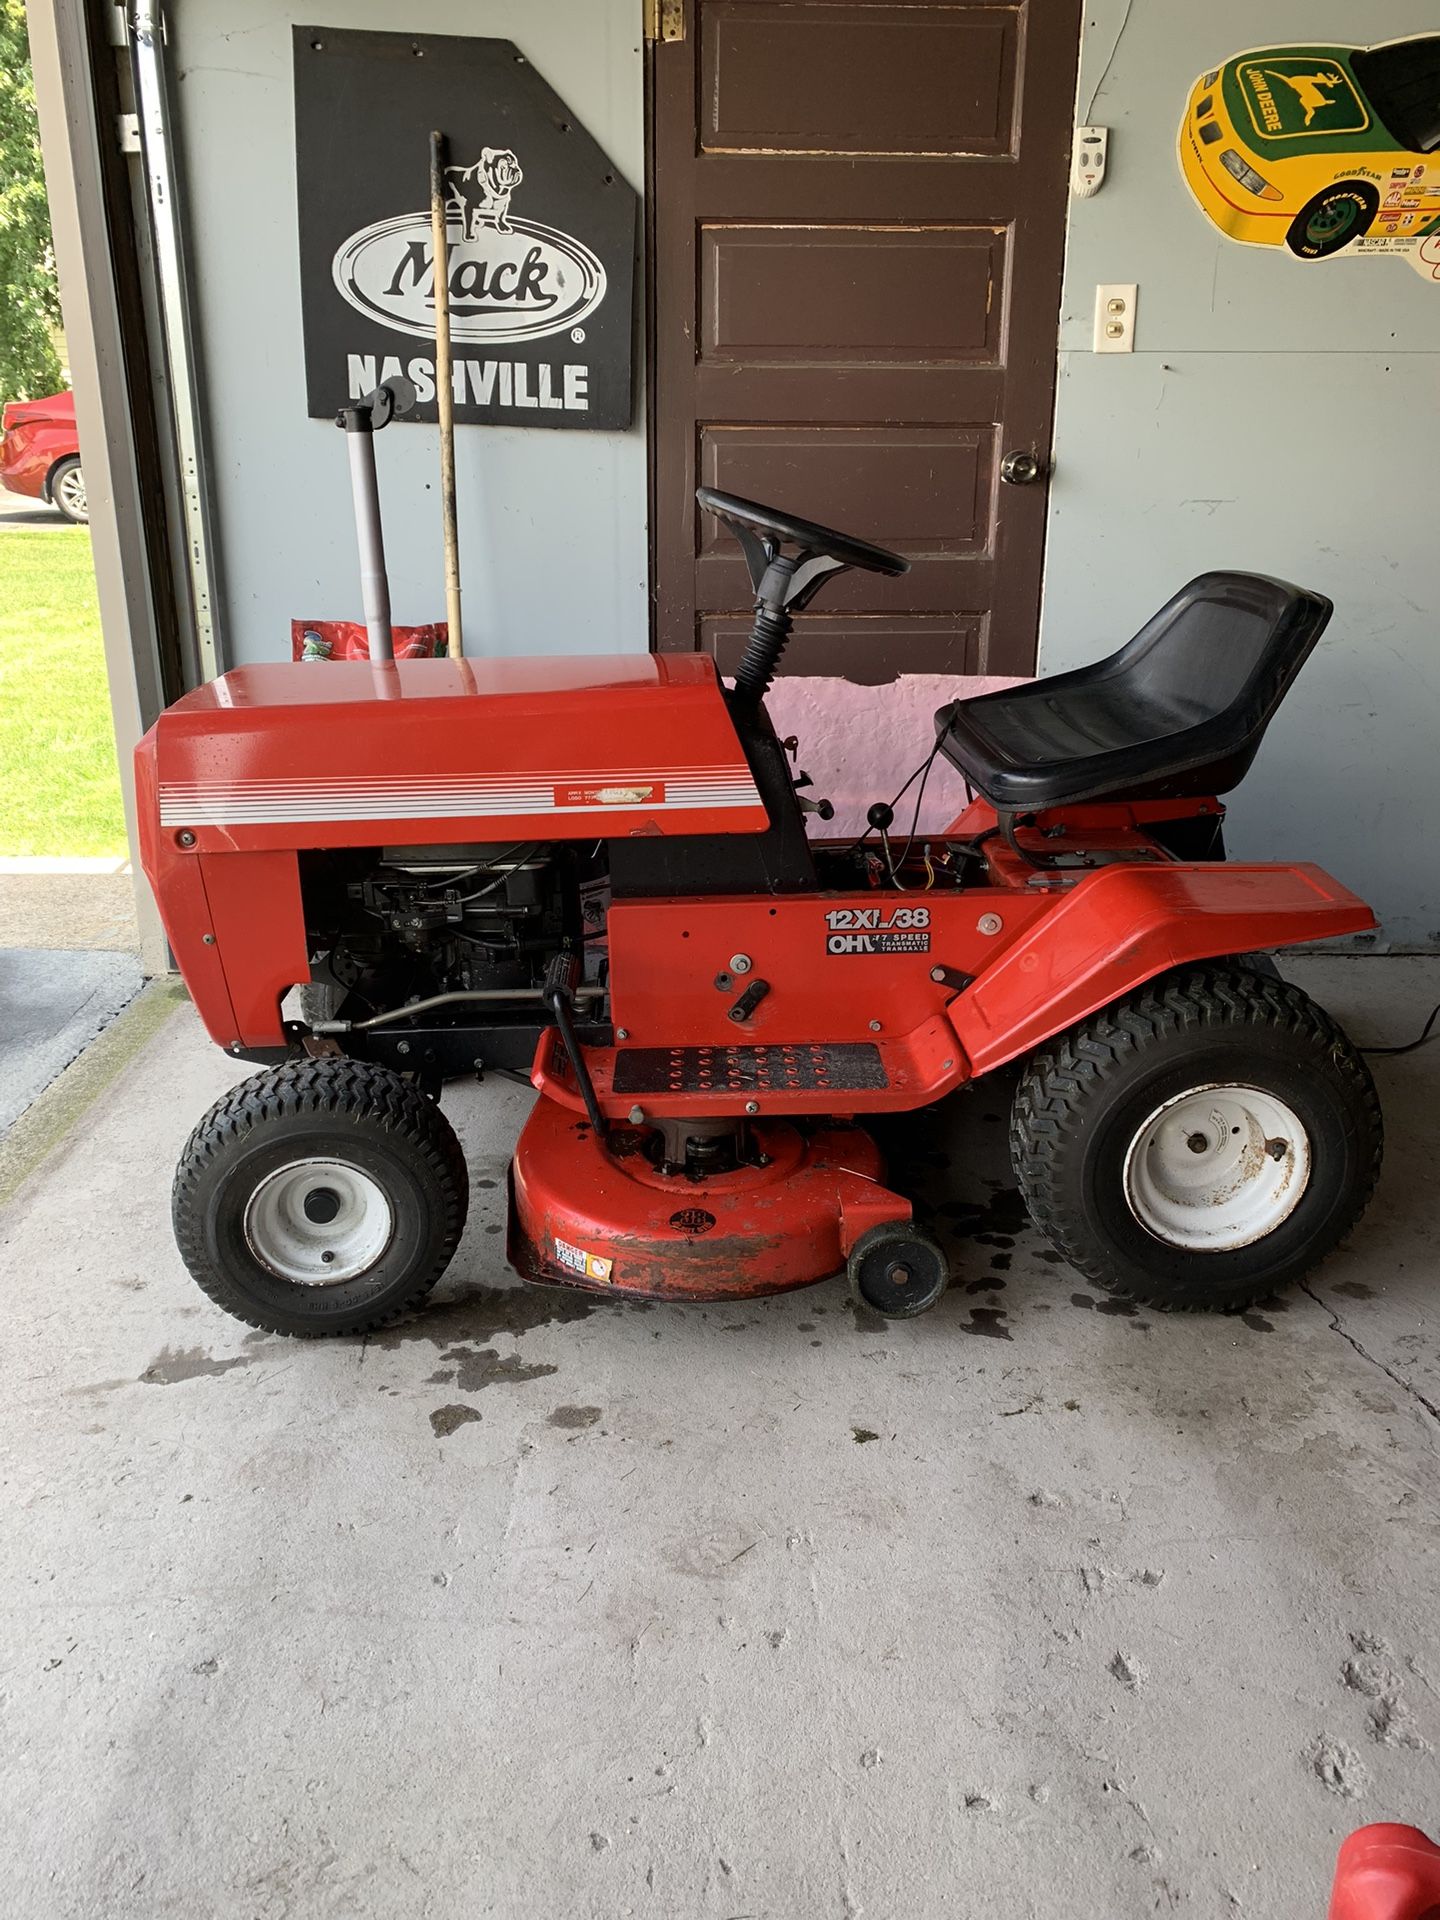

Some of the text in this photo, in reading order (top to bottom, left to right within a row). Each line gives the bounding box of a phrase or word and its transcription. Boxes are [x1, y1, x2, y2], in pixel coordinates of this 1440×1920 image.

[1246, 67, 1282, 132] JOHN DEERE
[1333, 166, 1382, 181] GOODYEAR
[382, 242, 558, 317] Mack
[680, 1210, 706, 1226] 38
